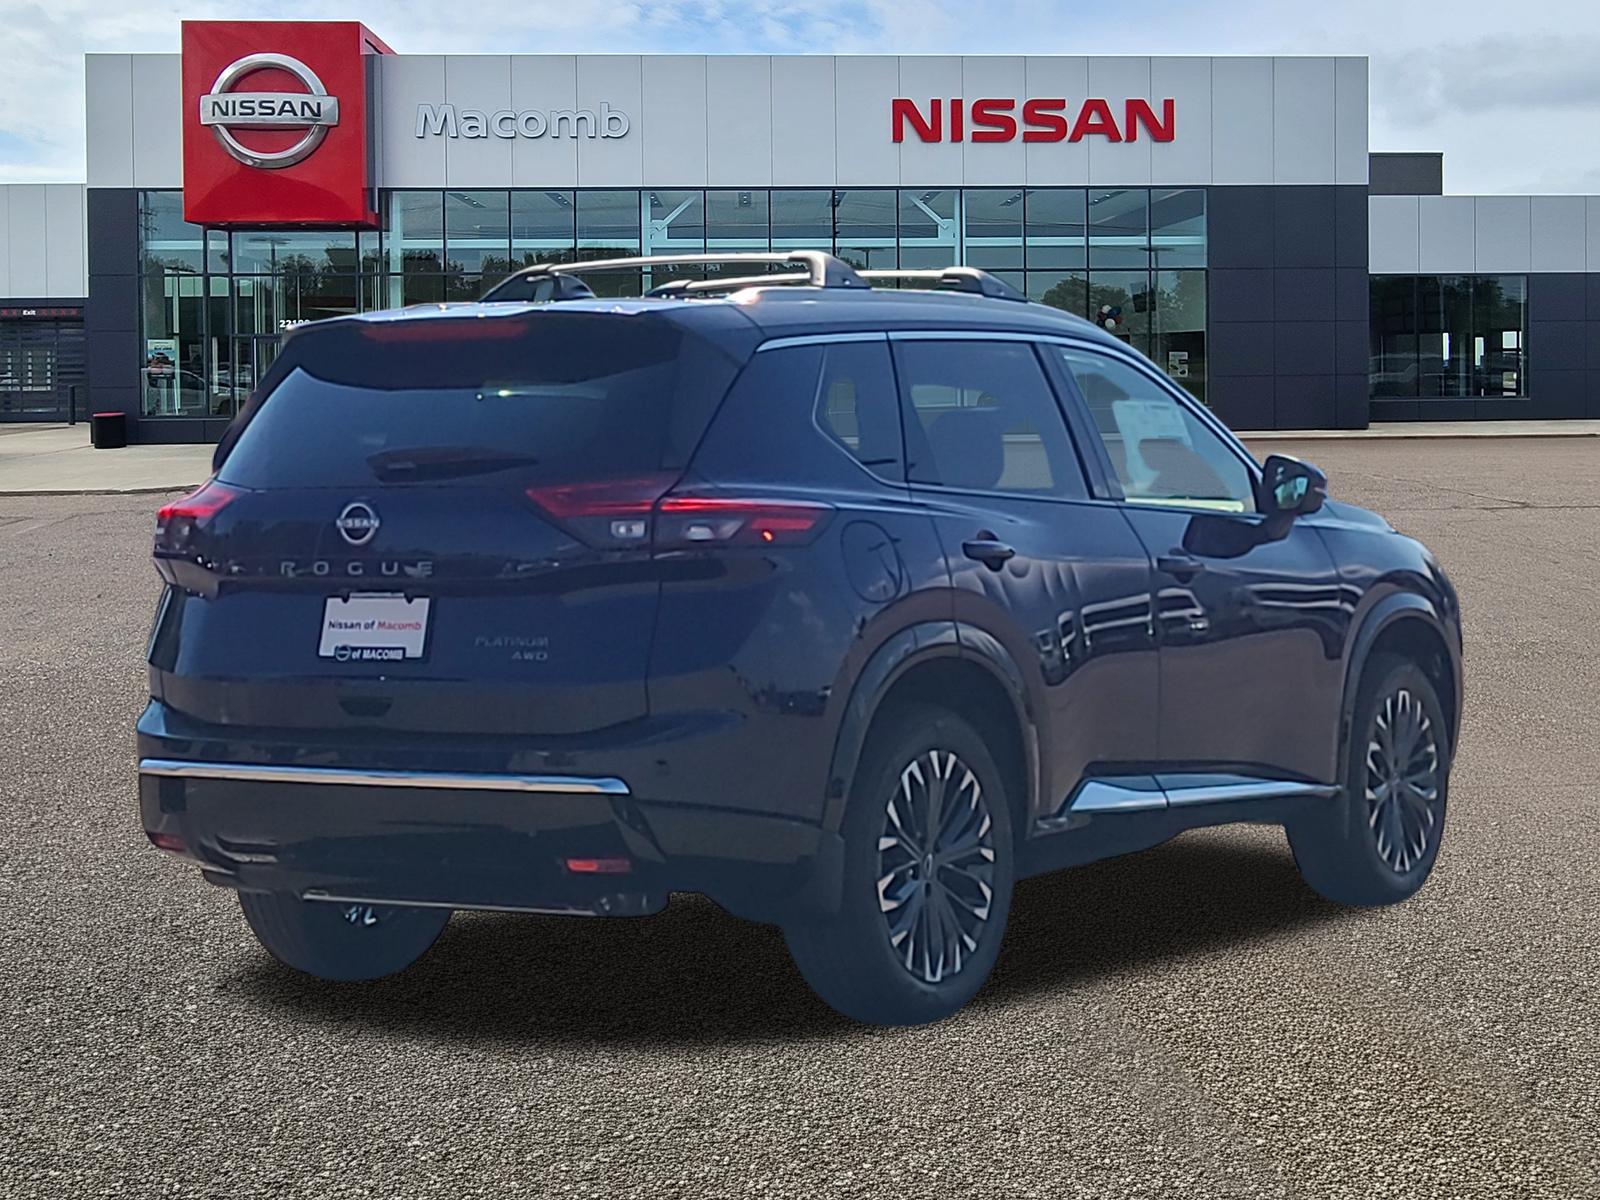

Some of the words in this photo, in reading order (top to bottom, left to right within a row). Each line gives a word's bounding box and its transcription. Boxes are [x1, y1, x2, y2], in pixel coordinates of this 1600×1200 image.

[211, 100, 322, 118] NISSAN
[415, 102, 630, 139] Macomb
[892, 98, 1175, 143] NISSAN
[336, 517, 380, 528] NISSAN
[281, 561, 433, 578] ROGUE
[328, 620, 361, 630] Nissan
[363, 620, 376, 630] of
[377, 621, 422, 630] Macomb
[474, 636, 549, 647] PLATINUM
[351, 649, 362, 659] of
[362, 649, 404, 660] MACOMB
[511, 650, 549, 660] AWD
